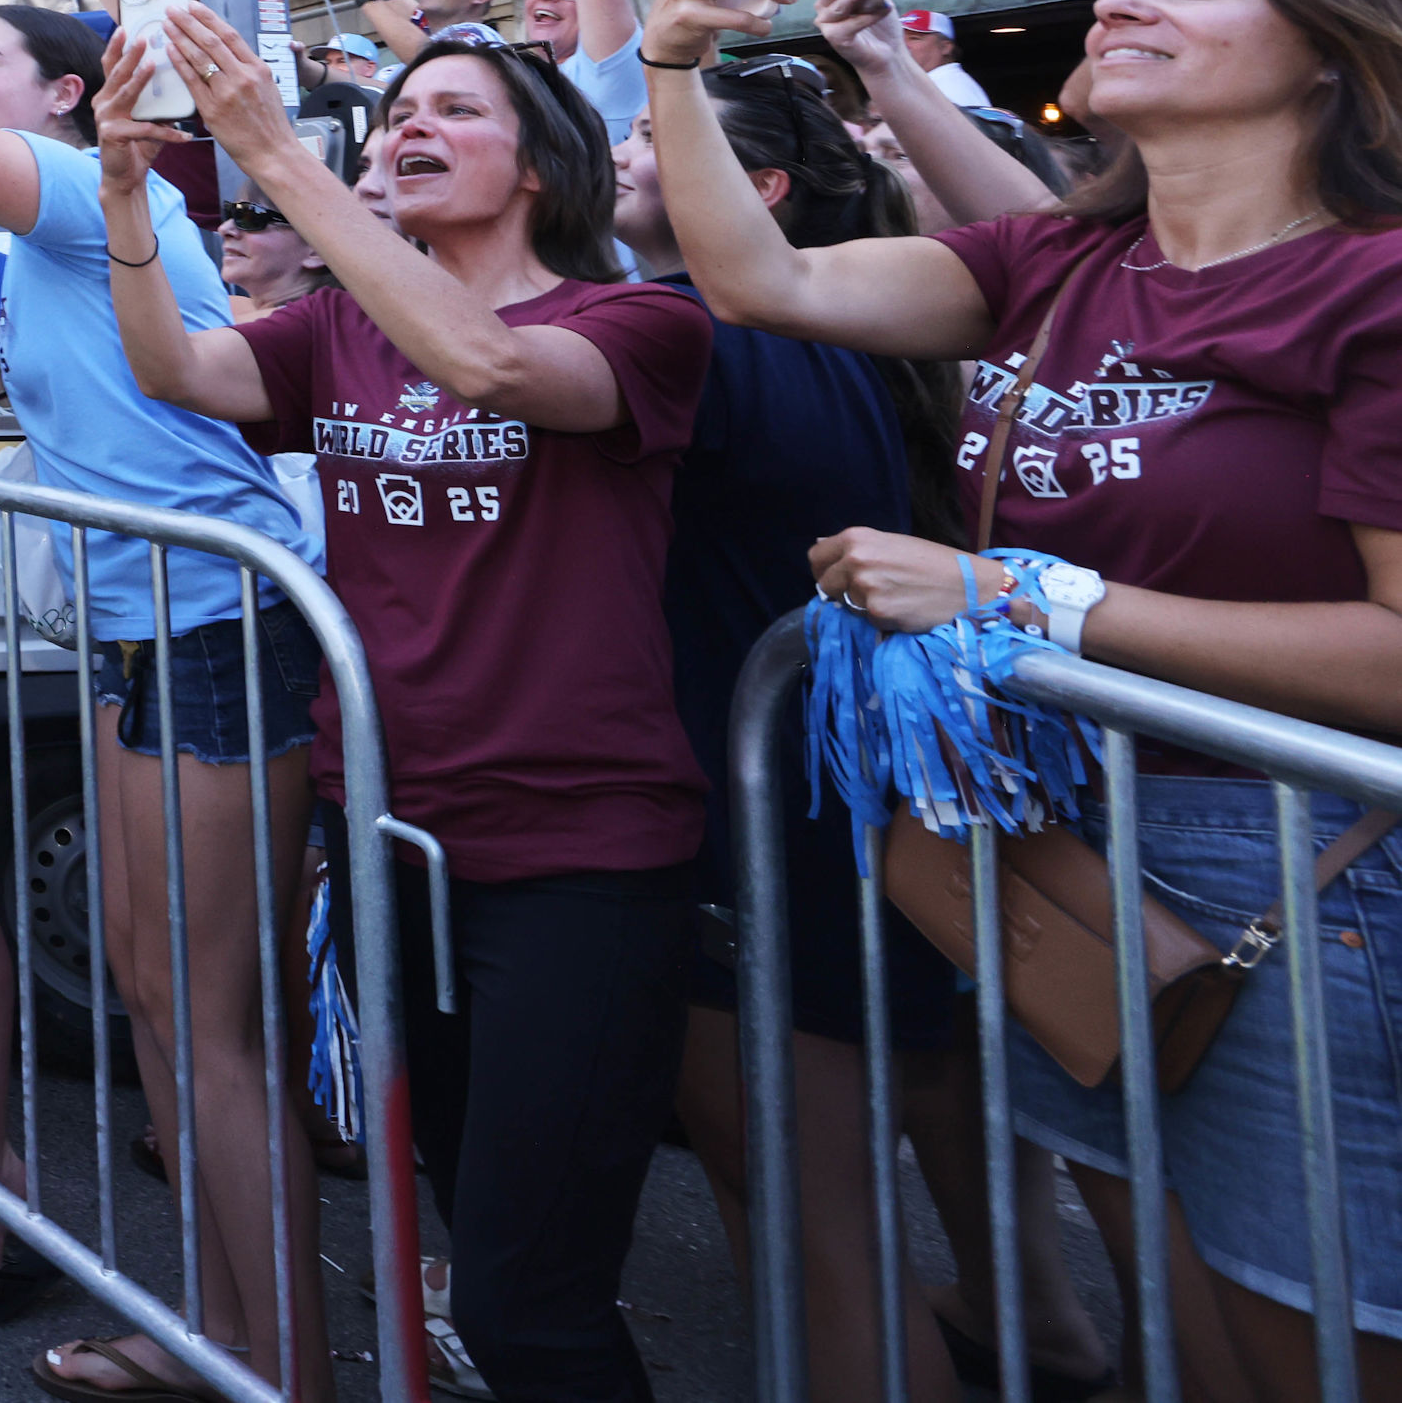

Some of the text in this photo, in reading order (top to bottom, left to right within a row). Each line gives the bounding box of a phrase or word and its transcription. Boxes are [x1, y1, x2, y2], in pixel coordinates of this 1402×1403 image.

[399, 424, 530, 464] SERIES
[1081, 437, 1142, 486] 25
[447, 486, 500, 522] 25
